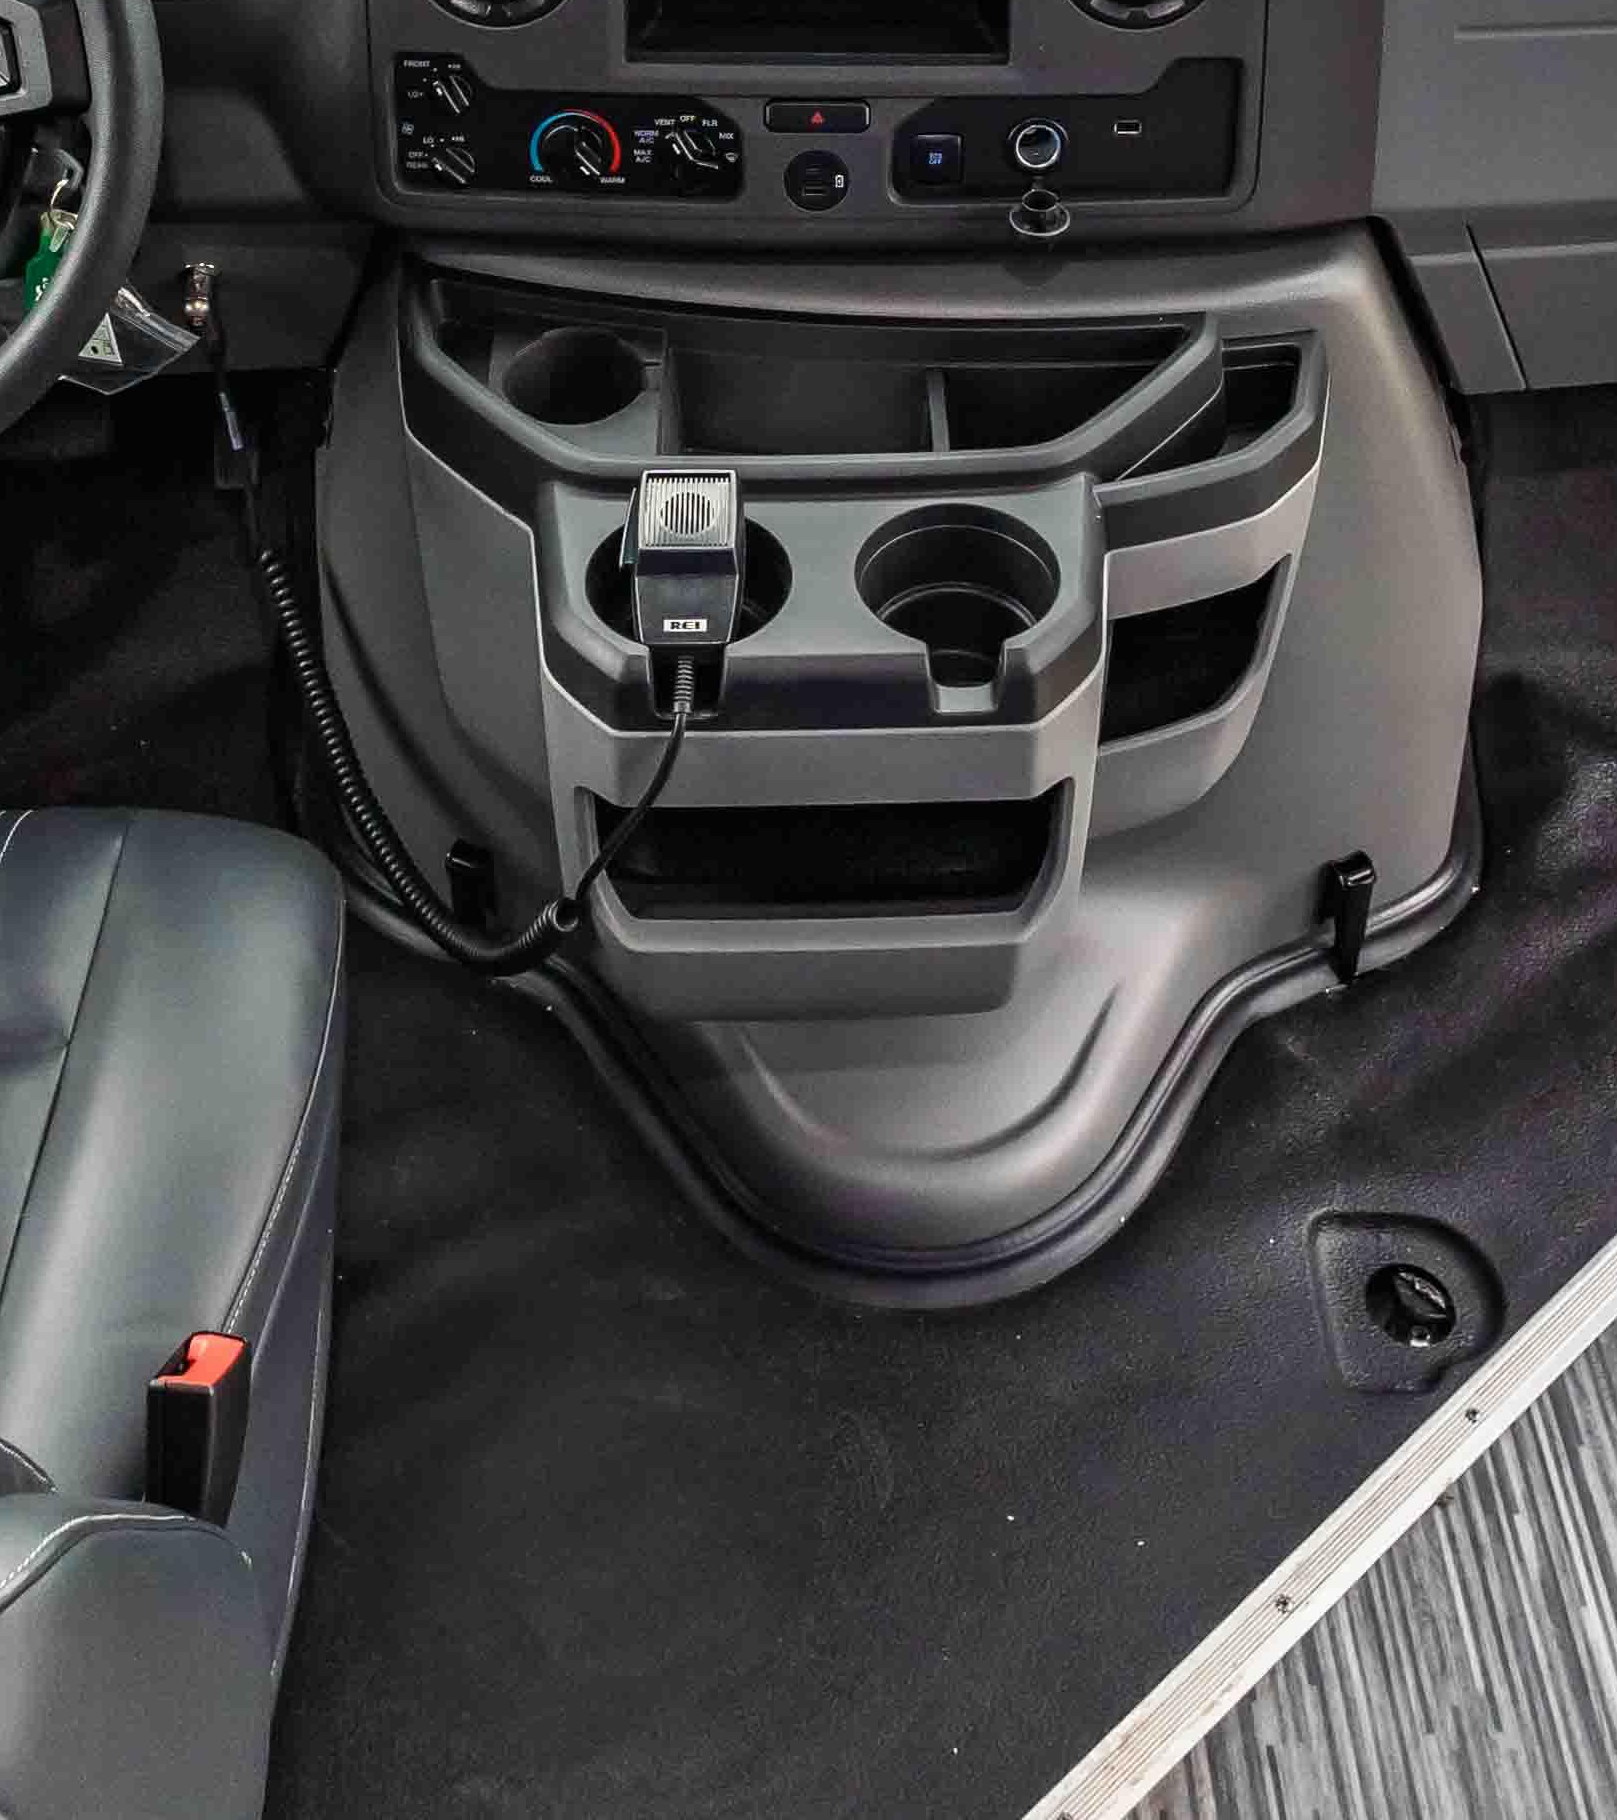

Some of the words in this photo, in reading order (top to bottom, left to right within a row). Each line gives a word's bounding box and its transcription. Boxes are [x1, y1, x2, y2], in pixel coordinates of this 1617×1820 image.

[654, 118, 675, 126] VENT
[719, 132, 734, 140] MIX
[530, 175, 551, 183] COOL
[670, 621, 701, 630] REI
